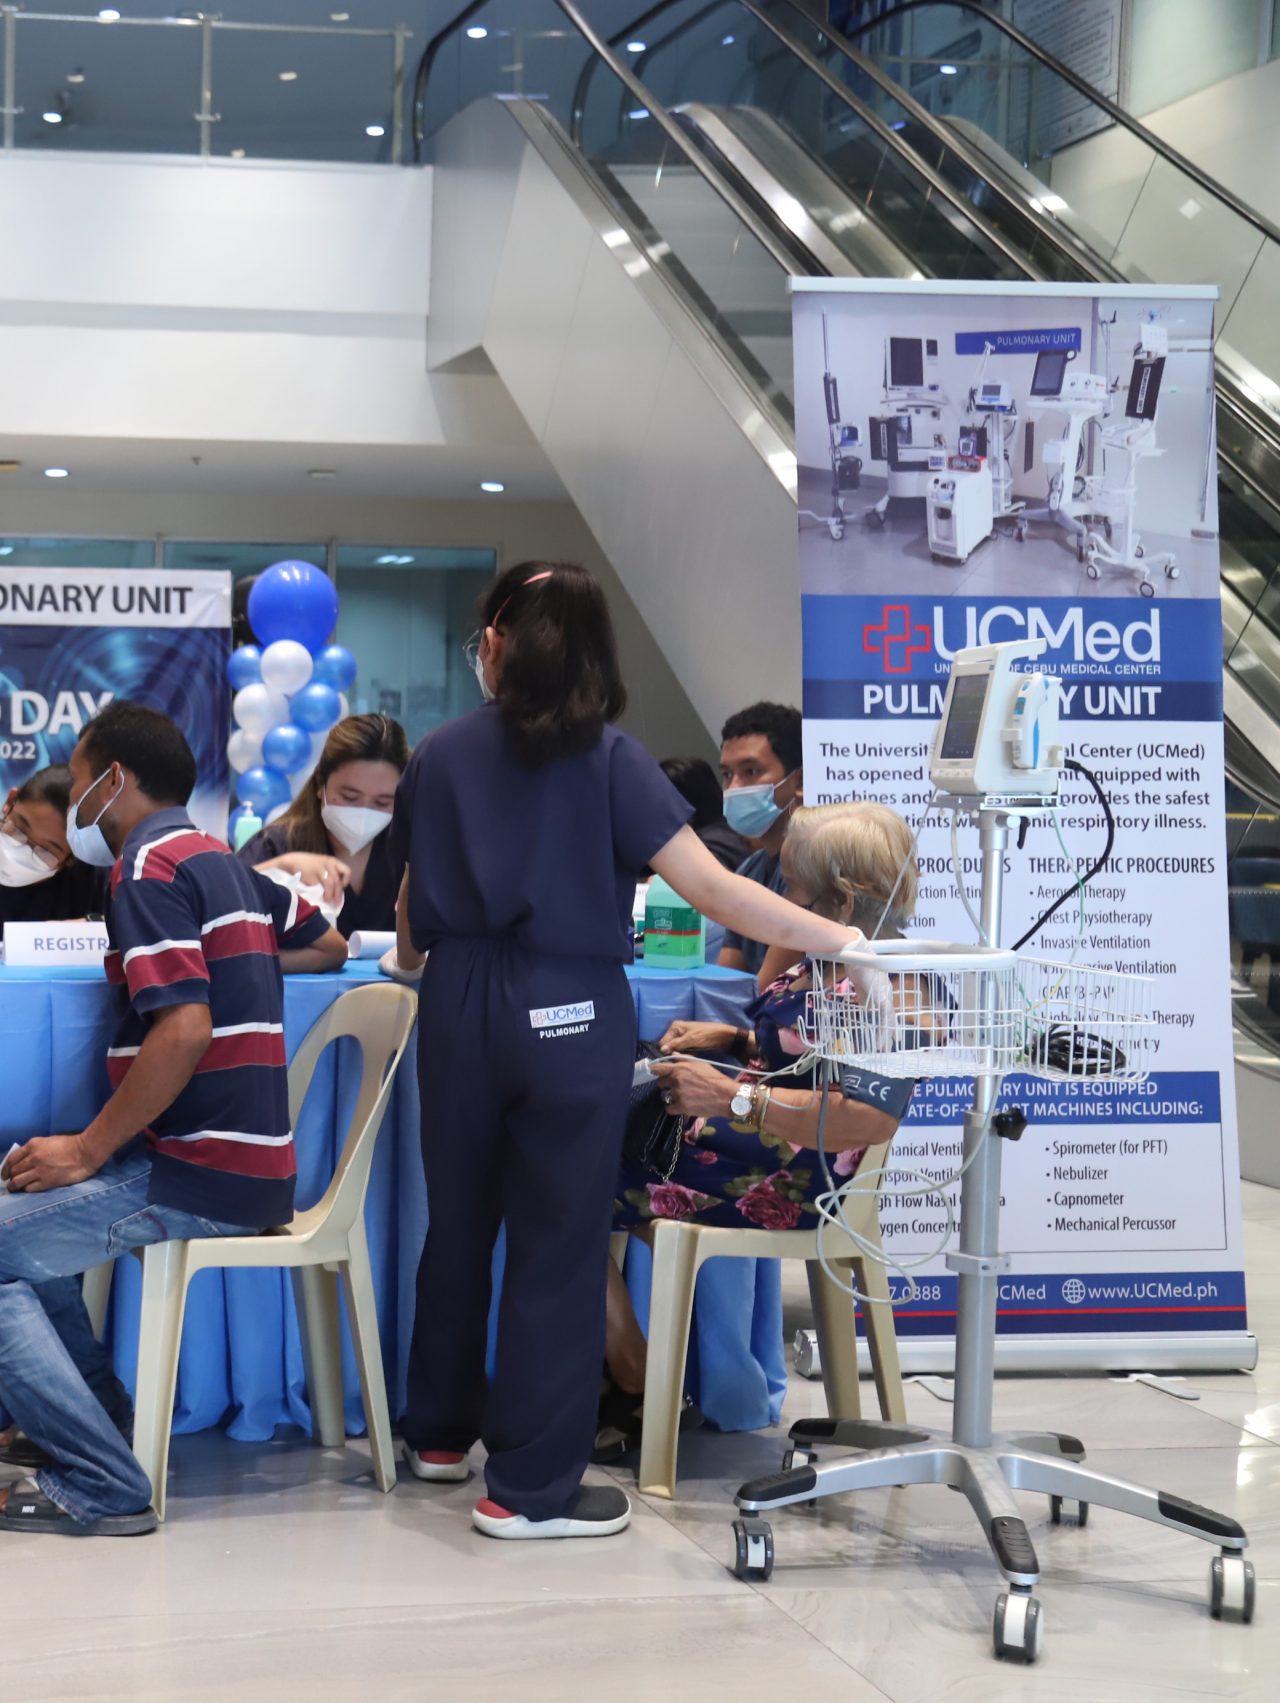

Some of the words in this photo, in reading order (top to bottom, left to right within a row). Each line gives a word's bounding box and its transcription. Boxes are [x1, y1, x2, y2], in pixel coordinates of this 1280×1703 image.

[997, 336, 1050, 346] PULMONARY
[1053, 333, 1075, 344] UNIT
[112, 585, 193, 615] UNIT
[933, 606, 1160, 662] UCMed
[1024, 664, 1056, 674] CEBU
[1061, 664, 1112, 674] MEDICAL
[1115, 664, 1161, 675] CENTER
[1085, 686, 1161, 715] UNIT
[820, 743, 850, 757] The
[855, 743, 927, 757] Universit
[1080, 744, 1132, 758] Center
[1137, 744, 1205, 760] (UCMed)
[827, 766, 859, 780] has
[860, 766, 923, 784] opened
[1058, 769, 1080, 780] nit
[1166, 768, 1200, 781] with
[818, 790, 896, 804] machines
[902, 790, 932, 804] and
[1135, 791, 1160, 805] the
[1165, 790, 1210, 805] safest
[905, 816, 950, 828] tients
[1061, 814, 1149, 831] respirtory
[1154, 814, 1206, 828] illness.
[1127, 857, 1215, 873] PROCEDURES
[1083, 885, 1126, 902] Therapy
[35, 937, 108, 950] REGISTR
[1090, 935, 1150, 949] Ventilation
[1115, 960, 1176, 974] Ventilation
[547, 1003, 592, 1020] UCMed
[1152, 1010, 1194, 1027] Therapy
[540, 1024, 589, 1039] PULMONARY
[1026, 1083, 1061, 1096] UNIT
[1066, 1083, 1078, 1095] IS
[1083, 1081, 1157, 1096] EQUIPPED
[1034, 1102, 1112, 1116] MACHINES
[1117, 1101, 1203, 1115] INCLUDING:
[931, 1142, 963, 1156] Ventil
[1053, 1140, 1116, 1158] Spirometer
[1119, 1140, 1139, 1156] (for
[1143, 1140, 1167, 1156] PFT)
[1054, 1166, 1108, 1180] Nebulizer
[896, 1195, 921, 1208] Flow
[1054, 1192, 1124, 1209] Capnometer
[1055, 1217, 1119, 1231] Mechanical
[1123, 1217, 1176, 1230] Percussor
[889, 1286, 941, 1300] 7.0888
[1088, 1282, 1218, 1300] www.UCMed.ph
